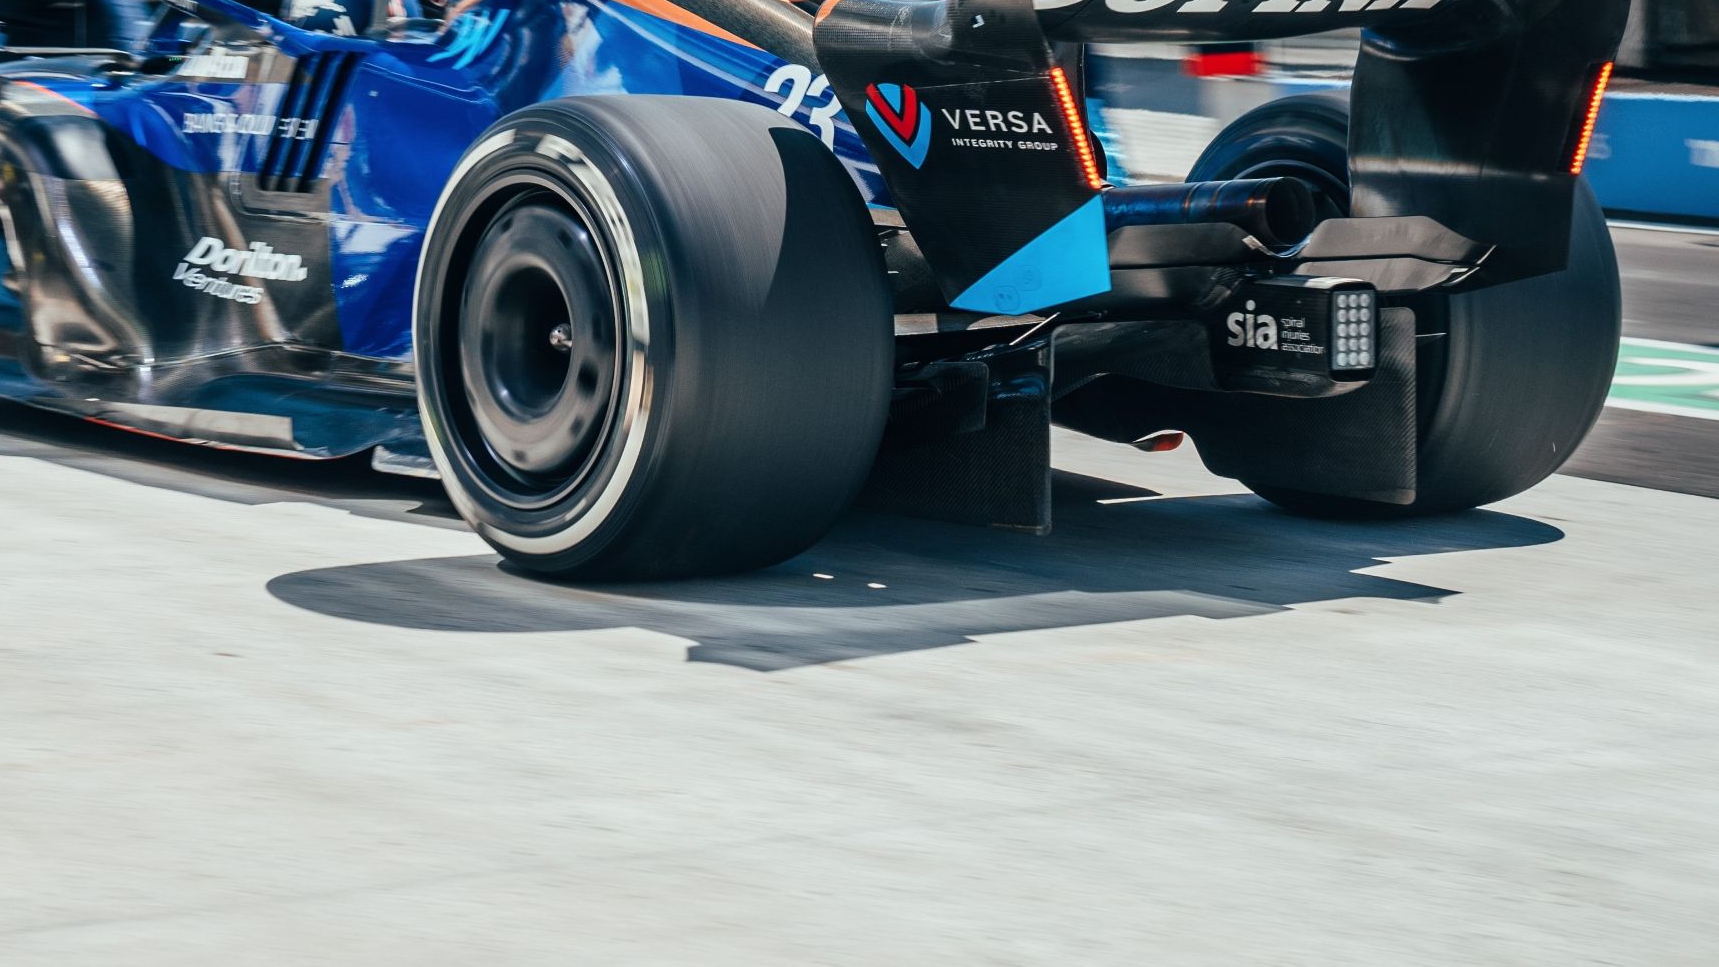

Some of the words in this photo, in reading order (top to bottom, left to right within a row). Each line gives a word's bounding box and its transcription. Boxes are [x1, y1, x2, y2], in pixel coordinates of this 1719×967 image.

[941, 108, 1053, 134] VERSA
[951, 138, 1013, 149] INTEGRITY
[1017, 141, 1059, 151] GROUP
[172, 262, 265, 305] Ventures
[1226, 299, 1278, 350] sia
